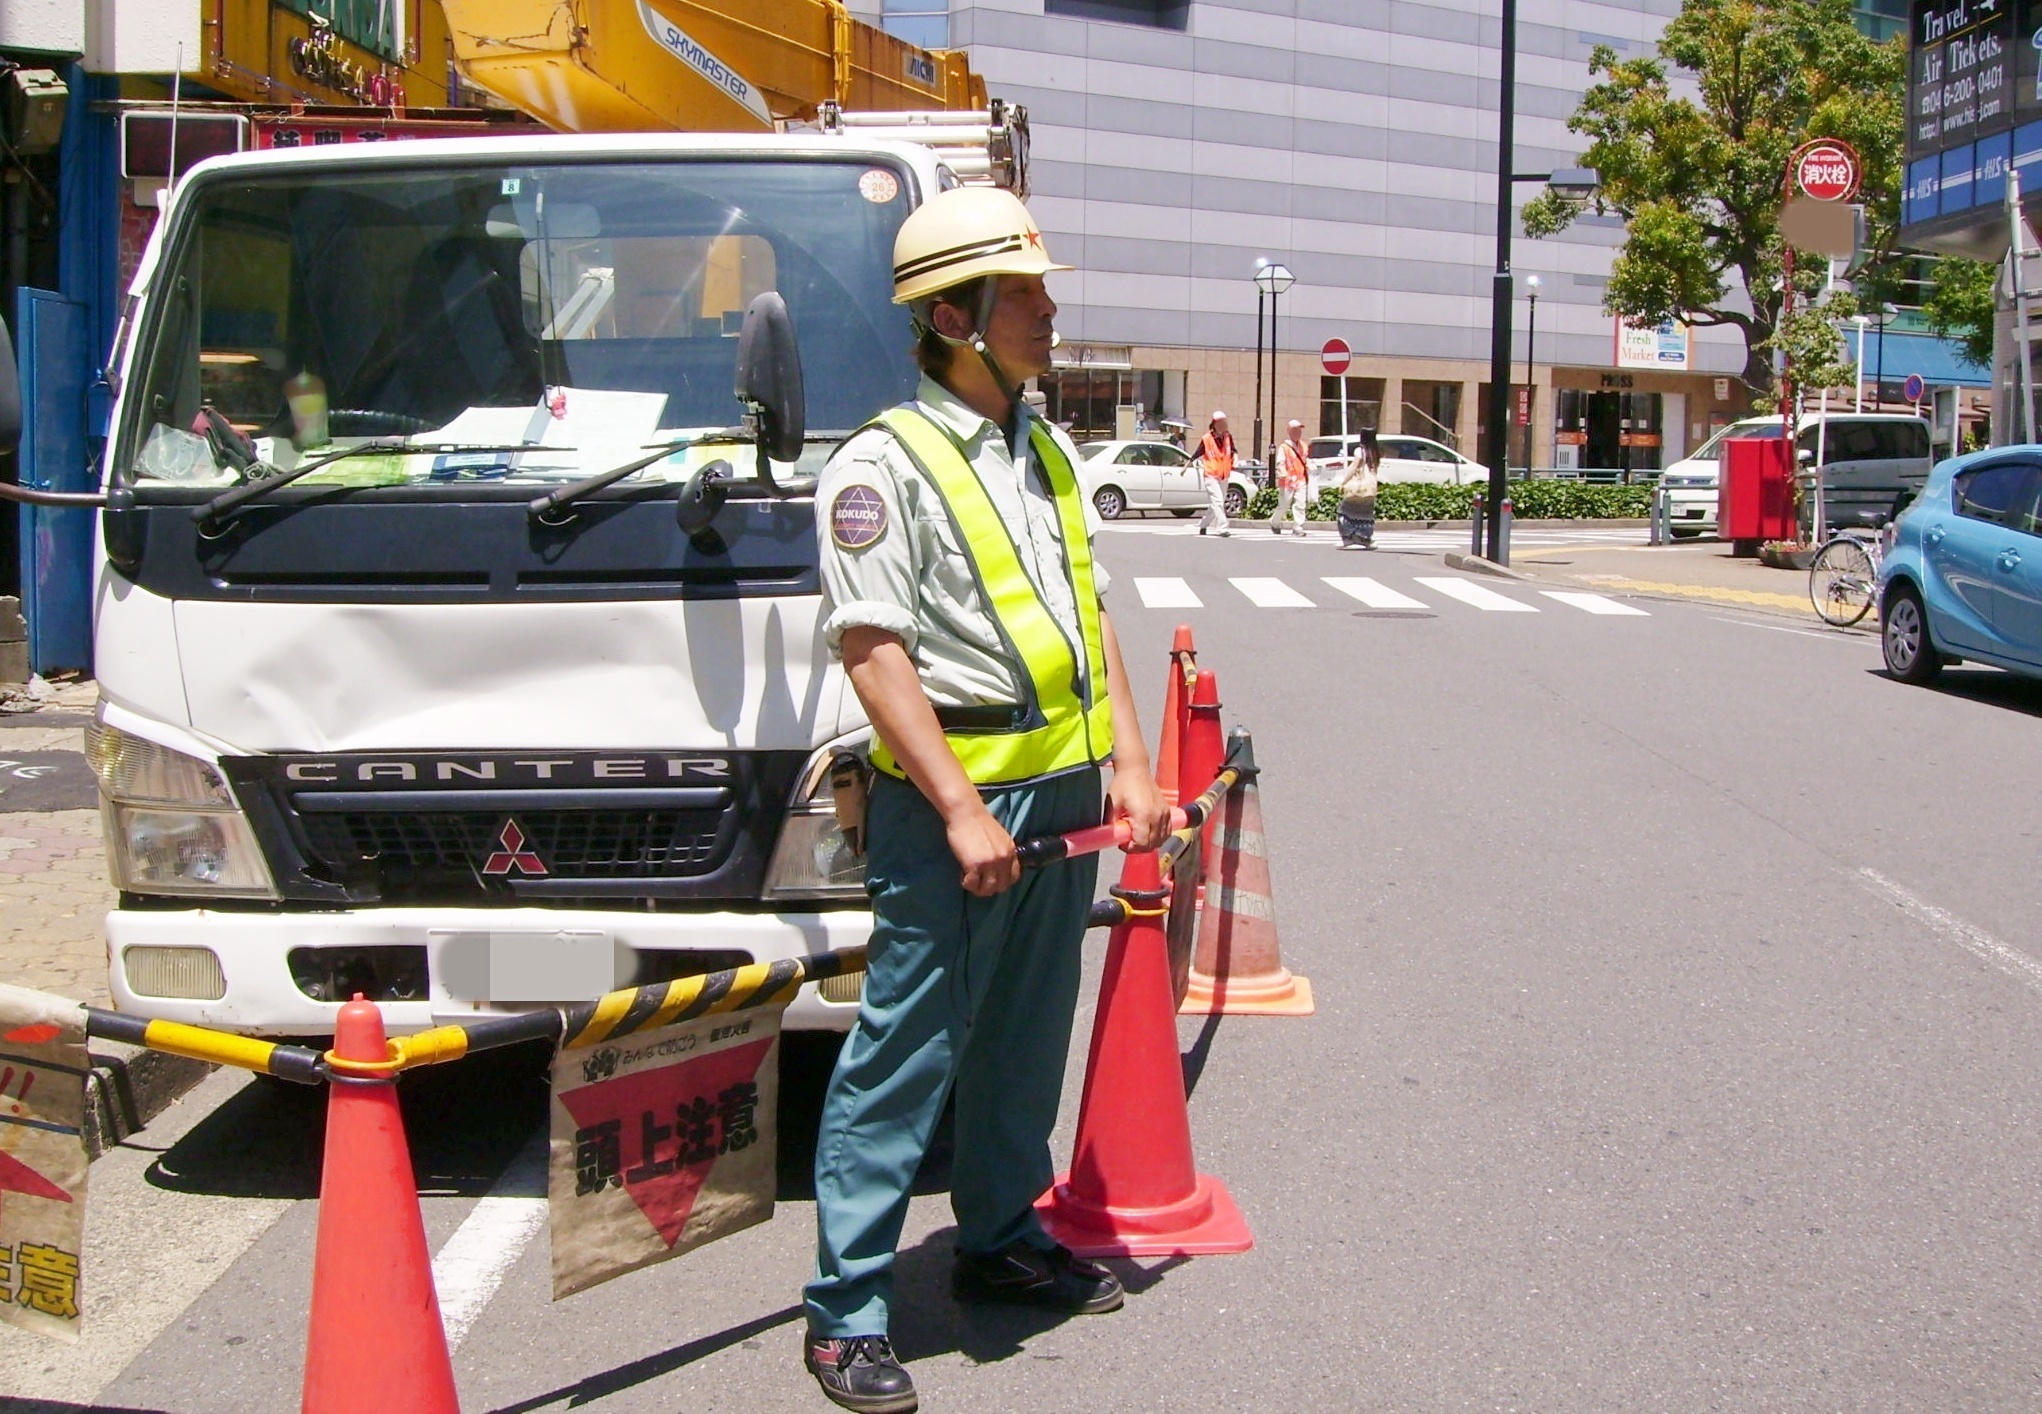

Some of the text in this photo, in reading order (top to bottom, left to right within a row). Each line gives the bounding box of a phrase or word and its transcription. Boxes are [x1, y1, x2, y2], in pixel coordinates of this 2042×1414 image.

[665, 27, 747, 100] SKYMASTER
[1921, 54, 1942, 86] Air
[1803, 164, 1847, 185] 消火栓
[1626, 332, 1651, 346] Fresh
[1621, 347, 1656, 362] Market
[835, 509, 879, 521] KOKUDO
[286, 758, 730, 781] CANTER
[574, 1081, 760, 1198] 頭上注意
